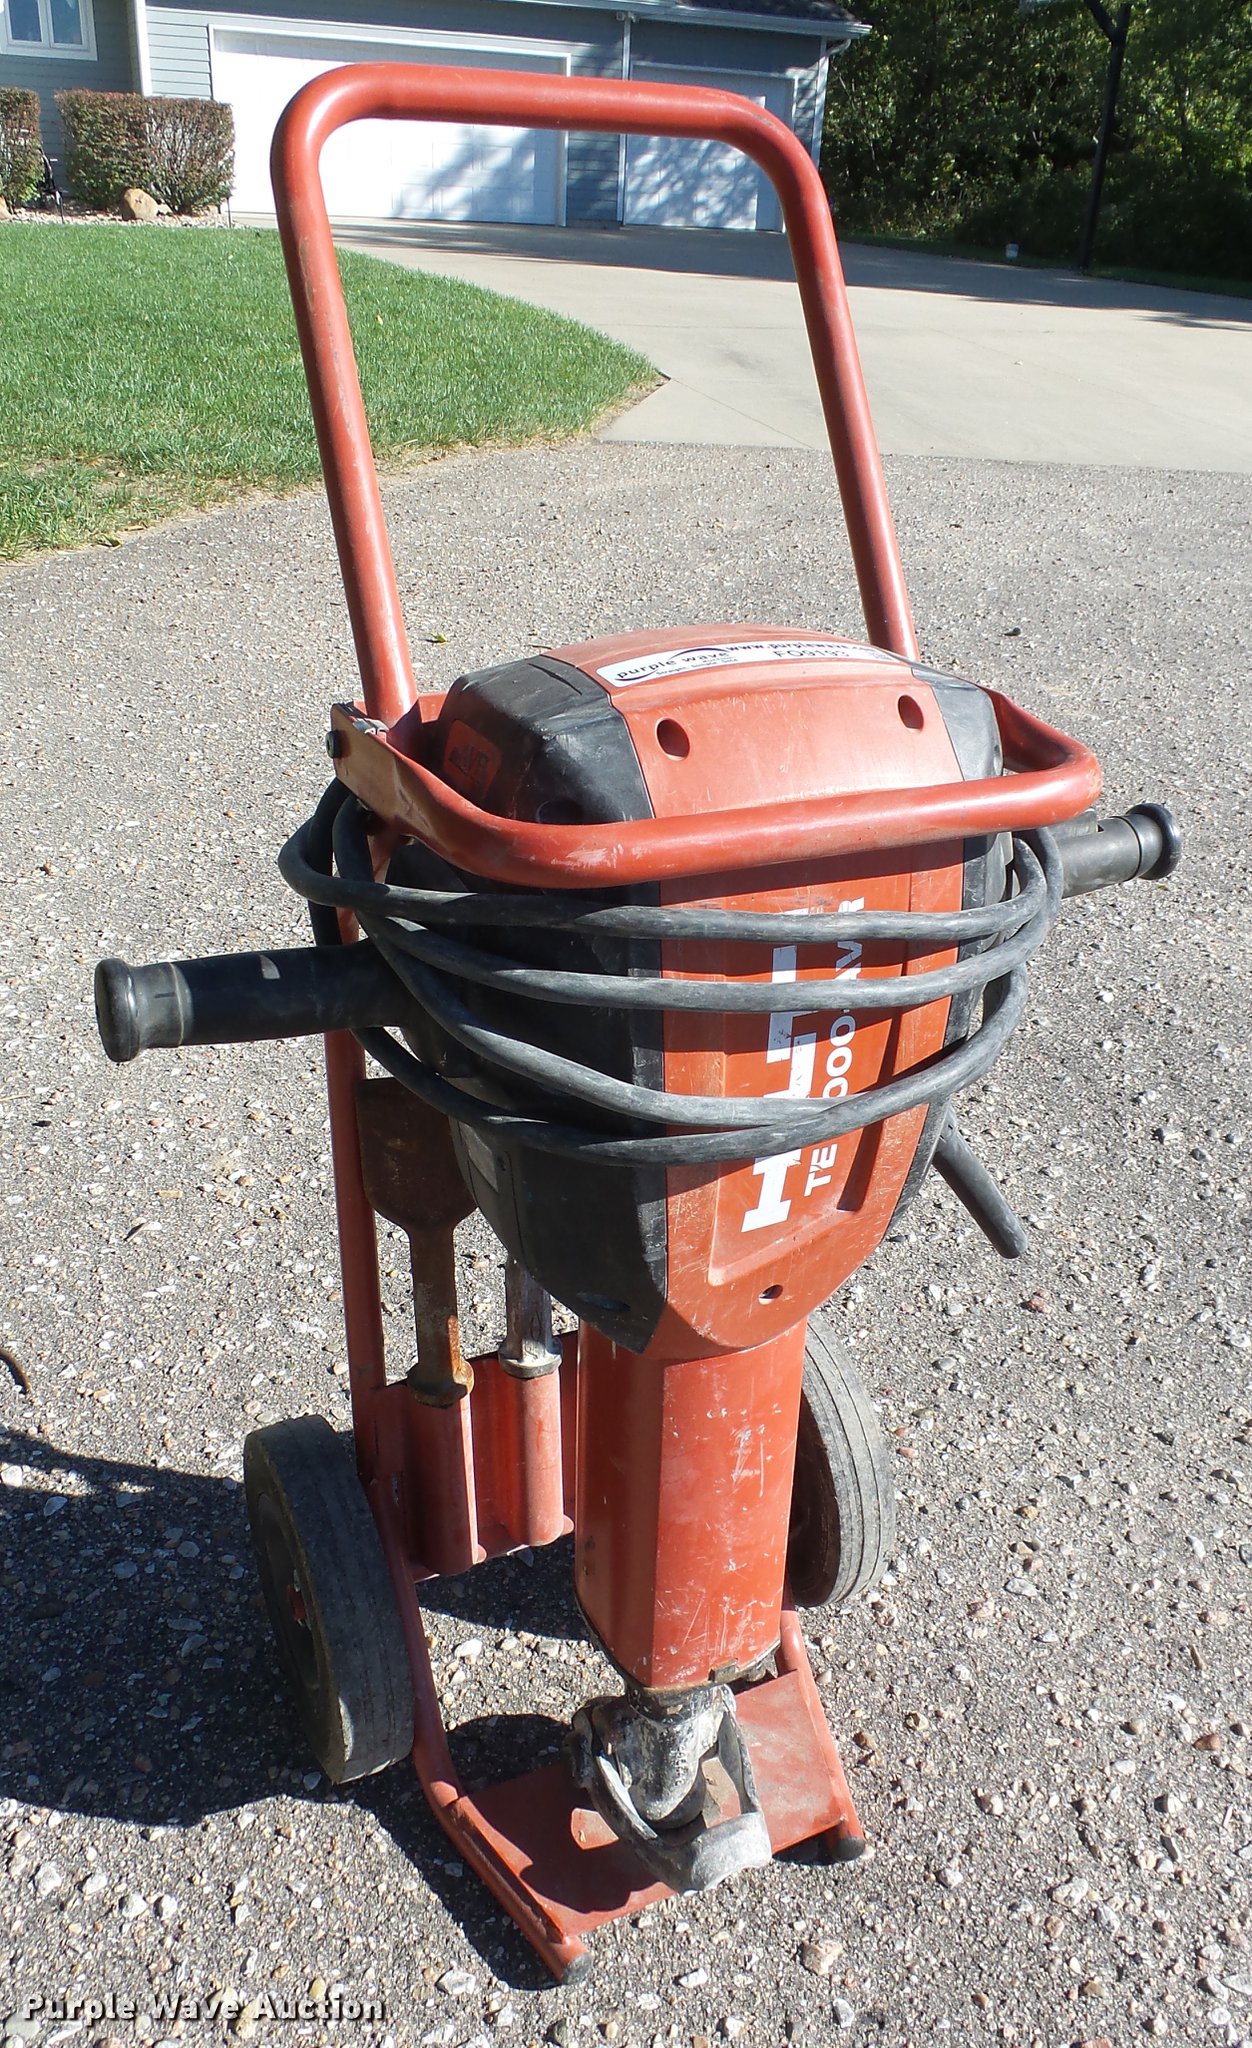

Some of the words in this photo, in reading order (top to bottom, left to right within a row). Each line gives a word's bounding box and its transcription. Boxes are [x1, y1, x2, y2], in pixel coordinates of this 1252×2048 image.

[616, 659, 677, 679] purple
[681, 652, 731, 663] wave
[804, 1143, 838, 1197] TE
